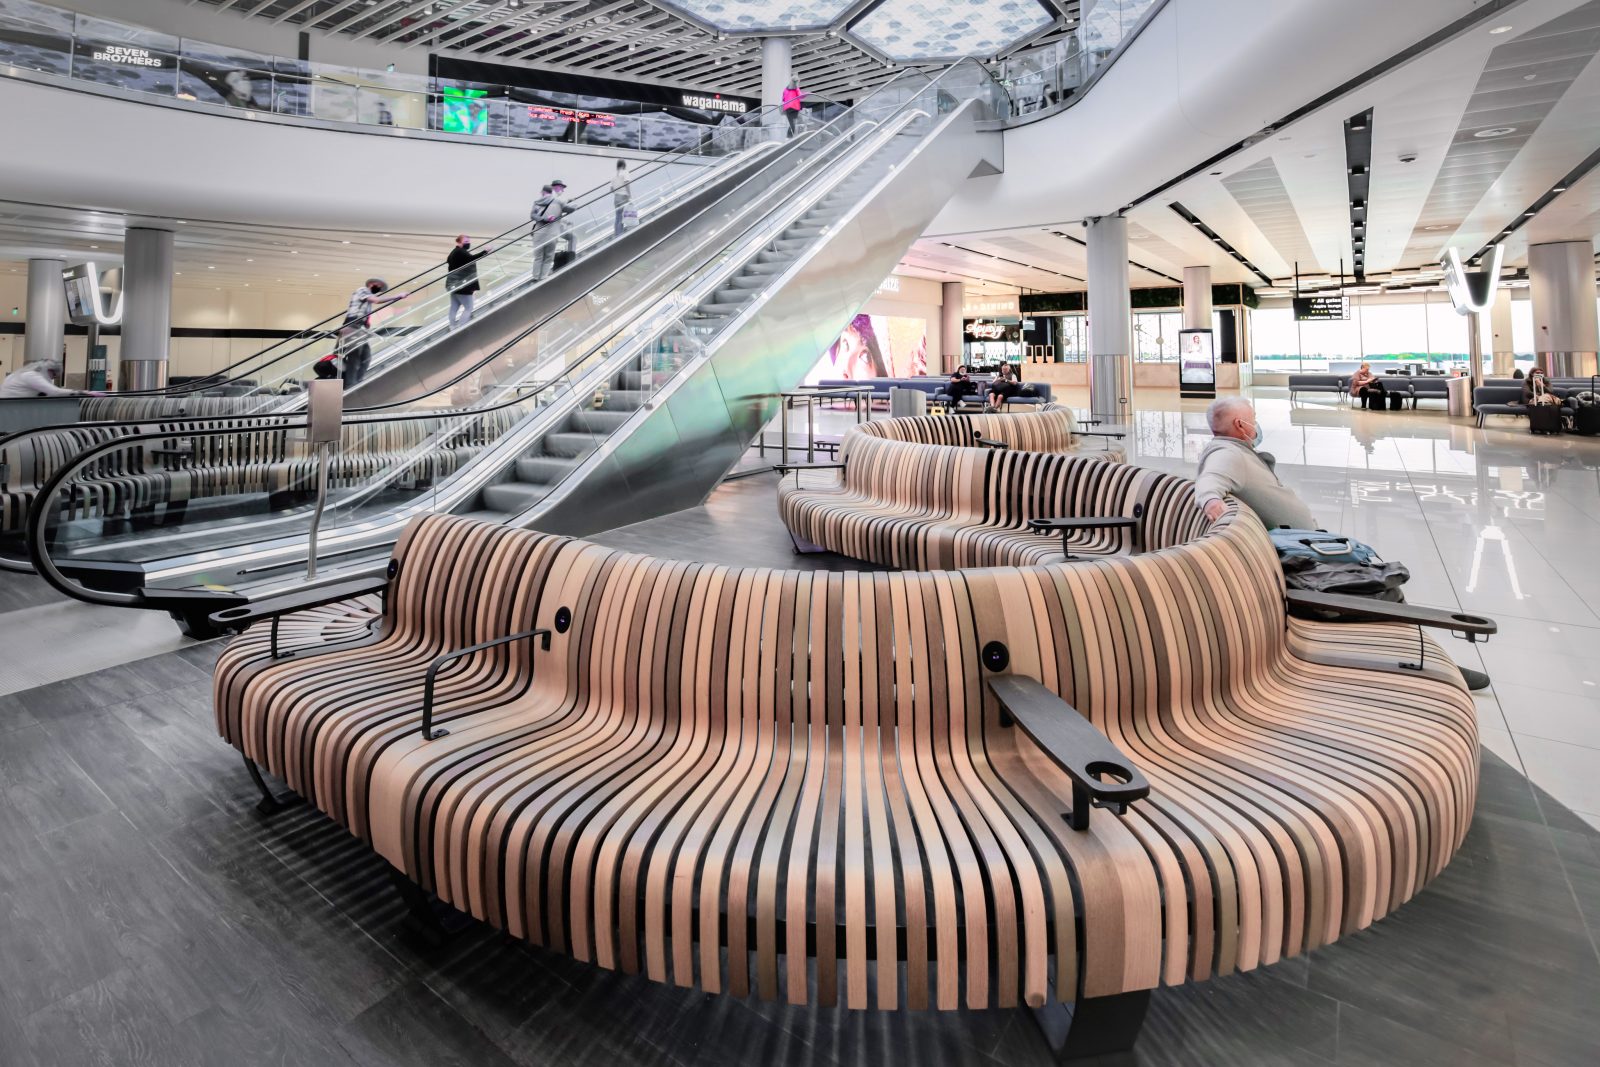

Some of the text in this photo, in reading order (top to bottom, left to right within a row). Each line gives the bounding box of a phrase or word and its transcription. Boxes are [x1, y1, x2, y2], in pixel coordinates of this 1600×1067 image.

[93, 52, 162, 67] BRO7HERS
[105, 46, 149, 58] SEVEN
[682, 95, 747, 113] wagamama
